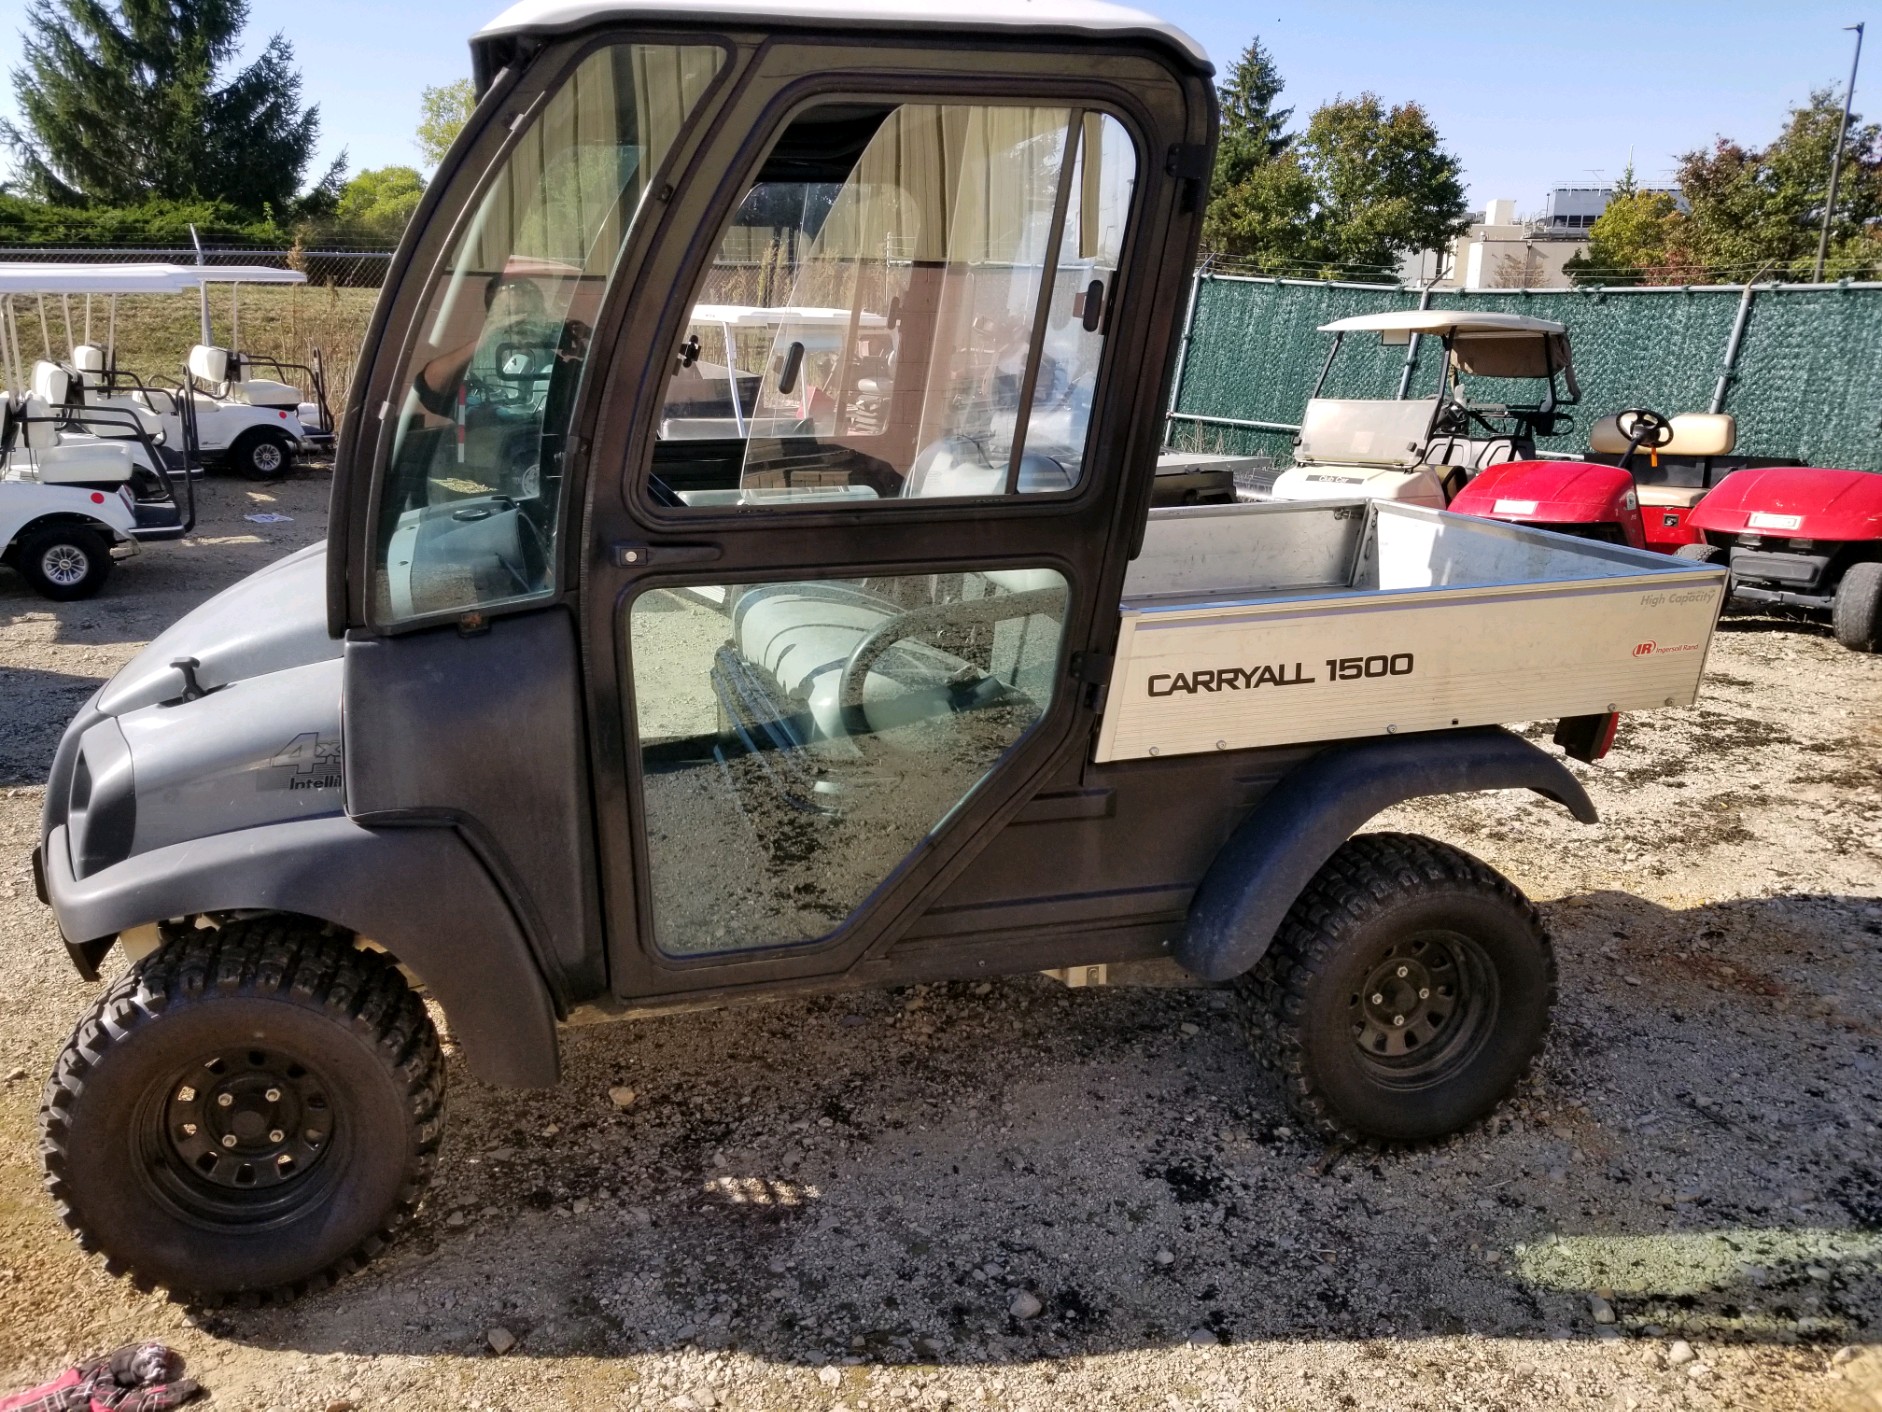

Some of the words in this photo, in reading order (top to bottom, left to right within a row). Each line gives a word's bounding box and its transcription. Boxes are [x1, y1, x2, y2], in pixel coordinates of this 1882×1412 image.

[1640, 593, 1666, 607] High
[1668, 591, 1716, 605] Capacity
[1634, 642, 1655, 656] IR
[1656, 644, 1683, 653] Ingersoll
[1148, 662, 1316, 698] CARRYALL
[1325, 652, 1414, 682] 1500
